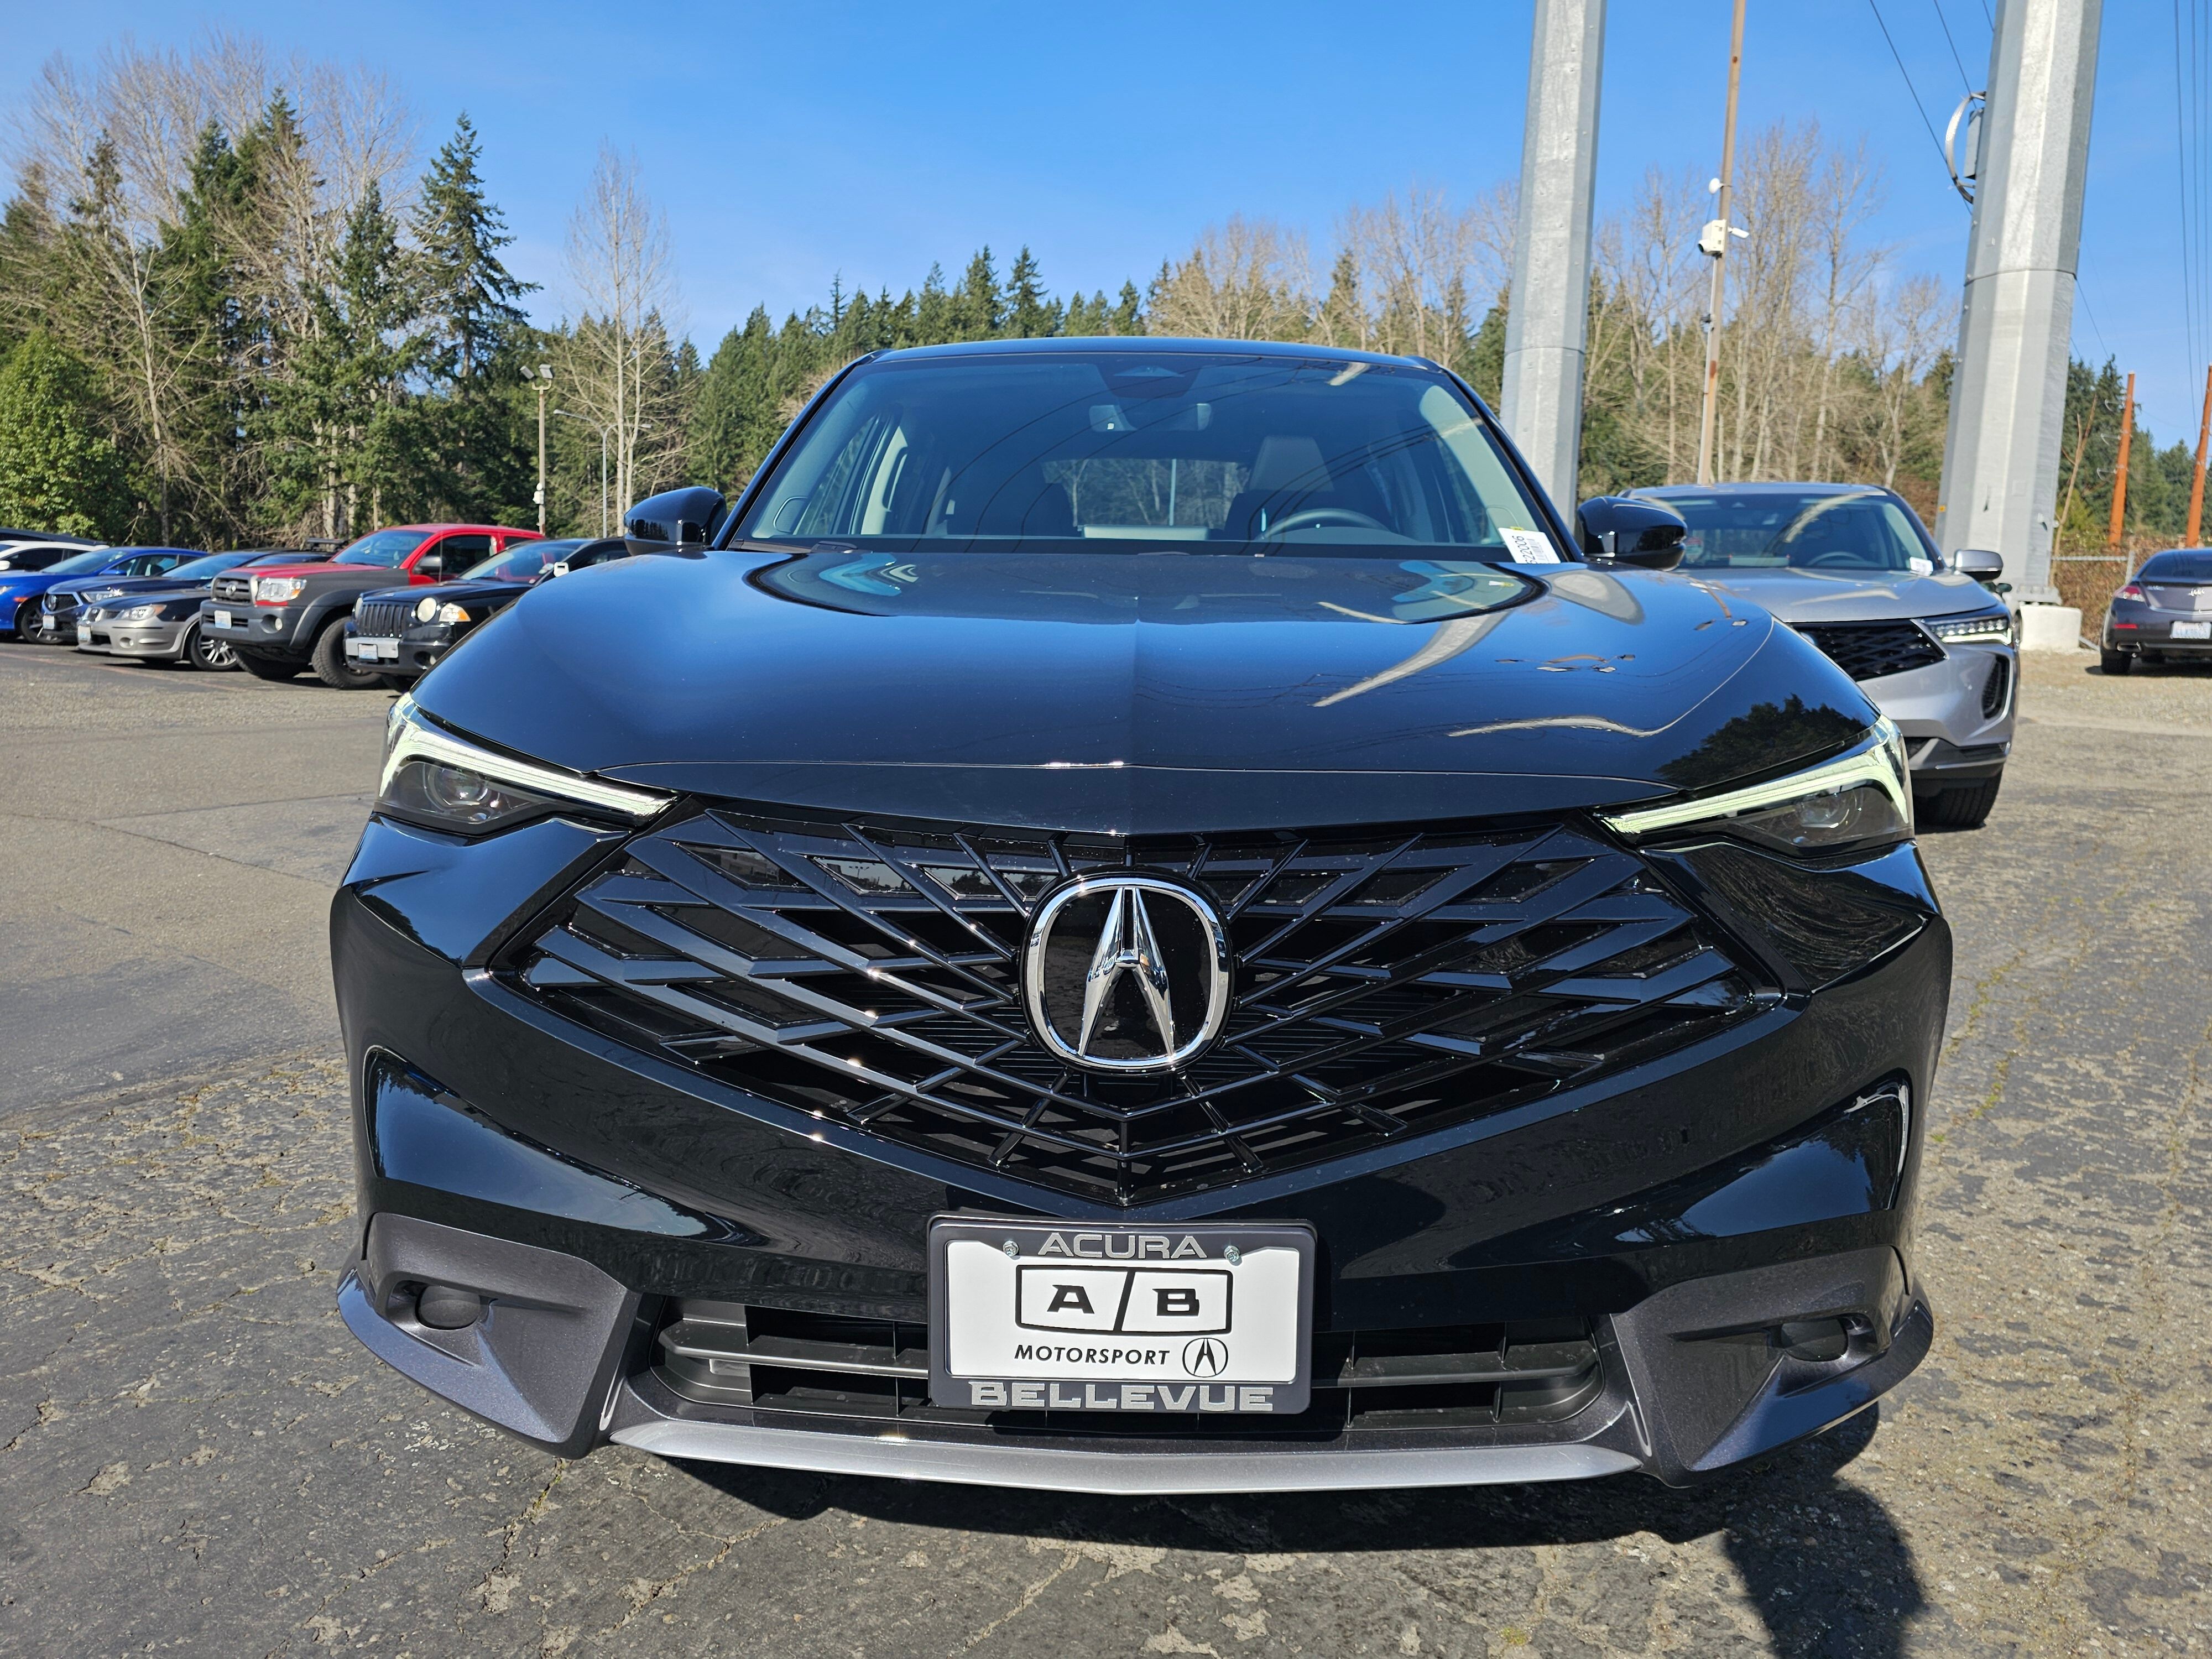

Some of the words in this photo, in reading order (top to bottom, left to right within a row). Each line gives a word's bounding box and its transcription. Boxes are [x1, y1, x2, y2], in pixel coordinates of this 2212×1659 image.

[1037, 1232, 1208, 1260] ACURA
[1046, 1284, 1095, 1314] A
[1152, 1288, 1200, 1317] B
[1014, 1344, 1171, 1365] MOTORSPORT
[968, 1381, 1274, 1411] BELLEVUE
